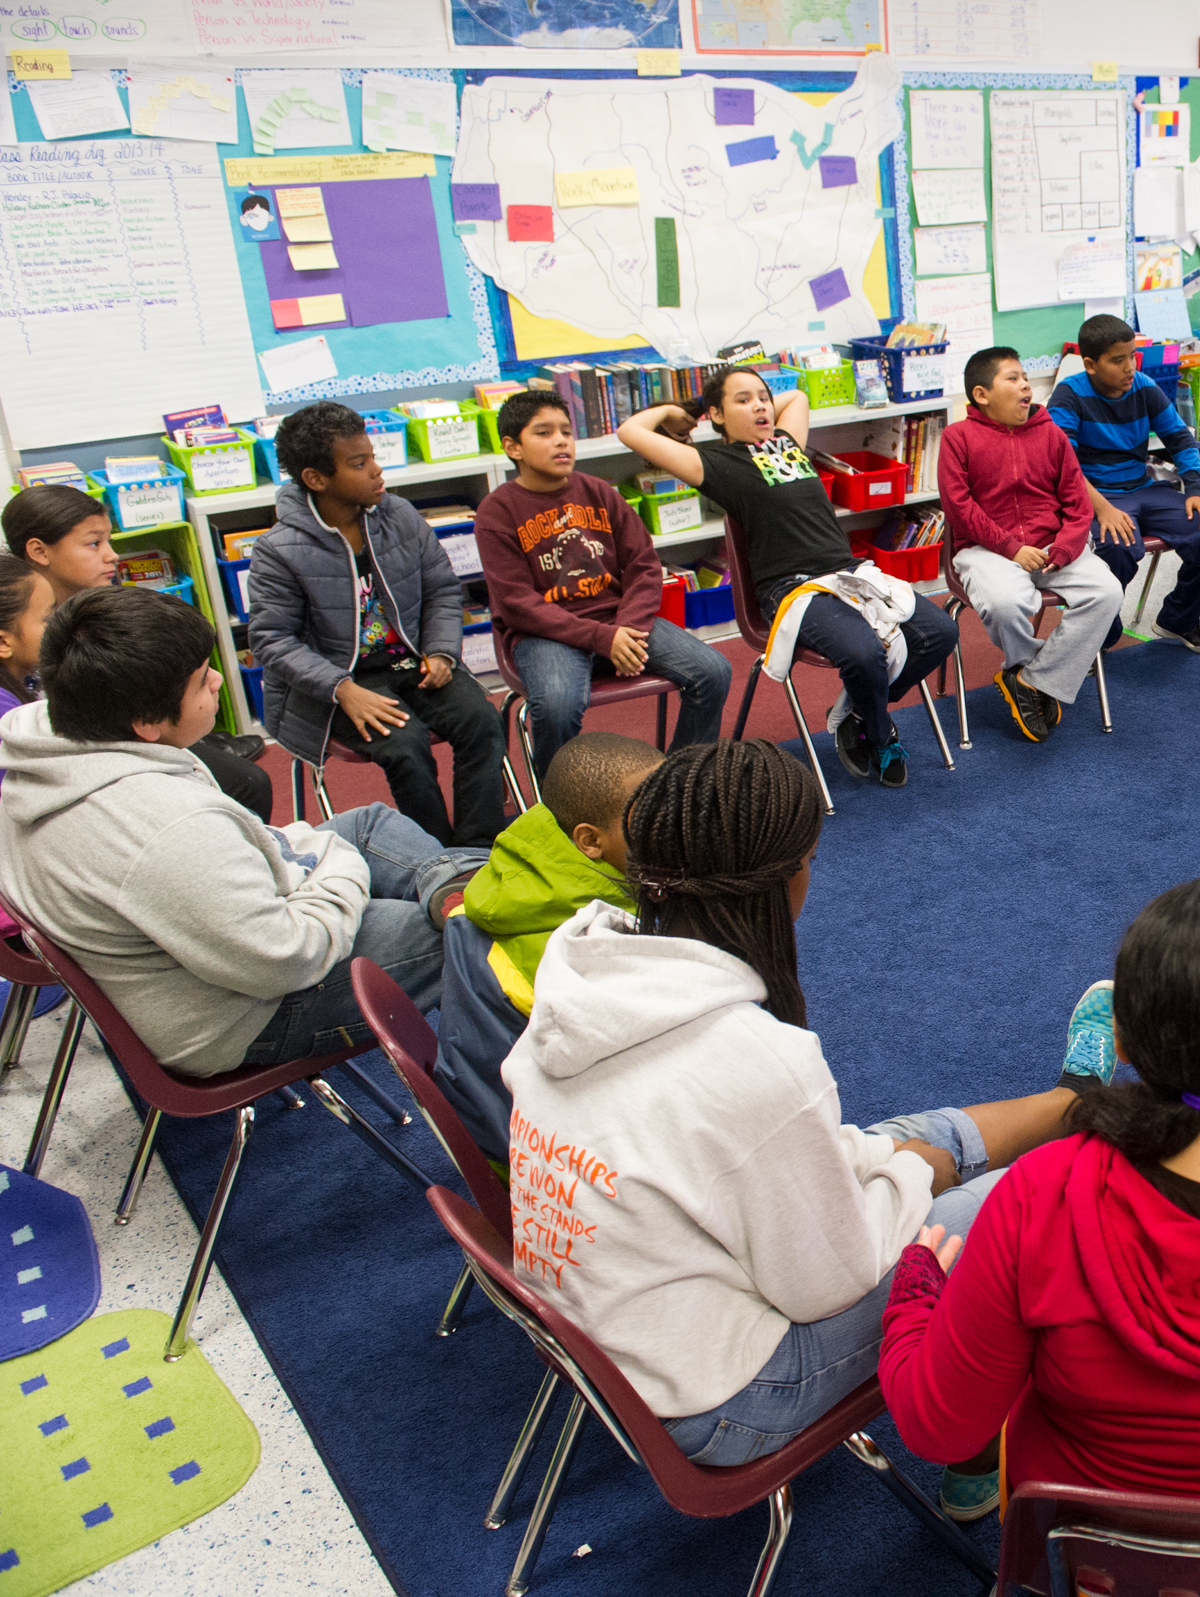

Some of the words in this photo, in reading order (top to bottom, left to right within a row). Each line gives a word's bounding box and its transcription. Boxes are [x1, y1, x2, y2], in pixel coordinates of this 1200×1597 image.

[193, 10, 228, 27] Person
[247, 10, 311, 31] Technology
[22, 22, 49, 42] sight
[62, 18, 91, 36] touch
[105, 22, 139, 36] sounds
[198, 28, 235, 45] Person
[15, 55, 54, 73] Reading
[30, 146, 80, 168] Reading
[114, 141, 165, 159] 2013-14
[130, 166, 157, 176] GENRE
[181, 165, 203, 175] TONE
[229, 164, 254, 181] Book
[257, 160, 318, 178] Recommendations
[7, 174, 29, 184] BOOK
[1, 190, 32, 203] Wonder
[61, 190, 91, 200] Palacio
[558, 179, 595, 201] Rocky
[592, 177, 637, 196] Mountain
[27, 240, 41, 248] Bad
[43, 238, 59, 247] Ants
[25, 287, 39, 297] The
[42, 287, 59, 295] Other
[434, 438, 452, 448] Jerry
[191, 460, 215, 471] Choose
[215, 457, 232, 471] Your
[233, 457, 249, 465] Own
[205, 466, 240, 479] Adventure
[214, 479, 234, 489] series
[136, 511, 165, 524] (series)
[553, 506, 575, 529] and
[562, 503, 612, 534] ROLL
[663, 510, 678, 519] Judy
[517, 508, 565, 553] ROCK
[144, 571, 163, 579] 2011
[462, 646, 490, 660] ealistic
[510, 1108, 618, 1199] MPIONSHIPS
[530, 1161, 579, 1210] WON
[517, 1185, 540, 1212] THE
[540, 1203, 597, 1244] STANDS
[522, 1217, 582, 1267] STILL
[514, 1239, 565, 1289] MPTY
